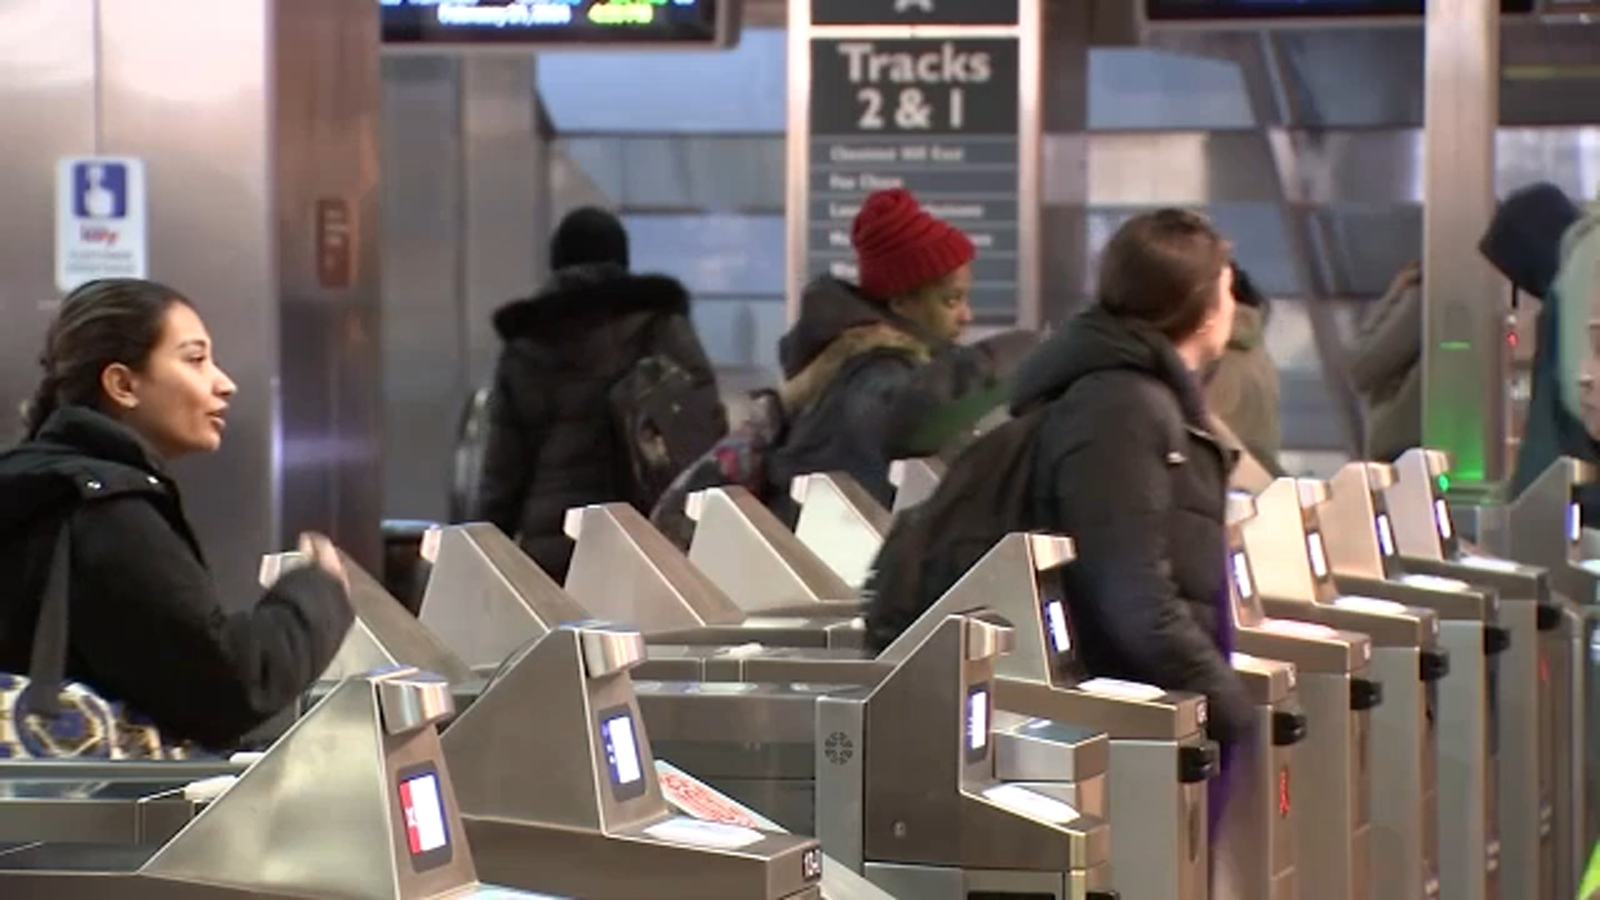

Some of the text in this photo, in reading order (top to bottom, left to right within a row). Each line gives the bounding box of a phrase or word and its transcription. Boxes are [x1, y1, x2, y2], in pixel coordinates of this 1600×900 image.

[838, 42, 992, 82] Tracks
[857, 88, 884, 129] 2
[895, 88, 932, 129] &
